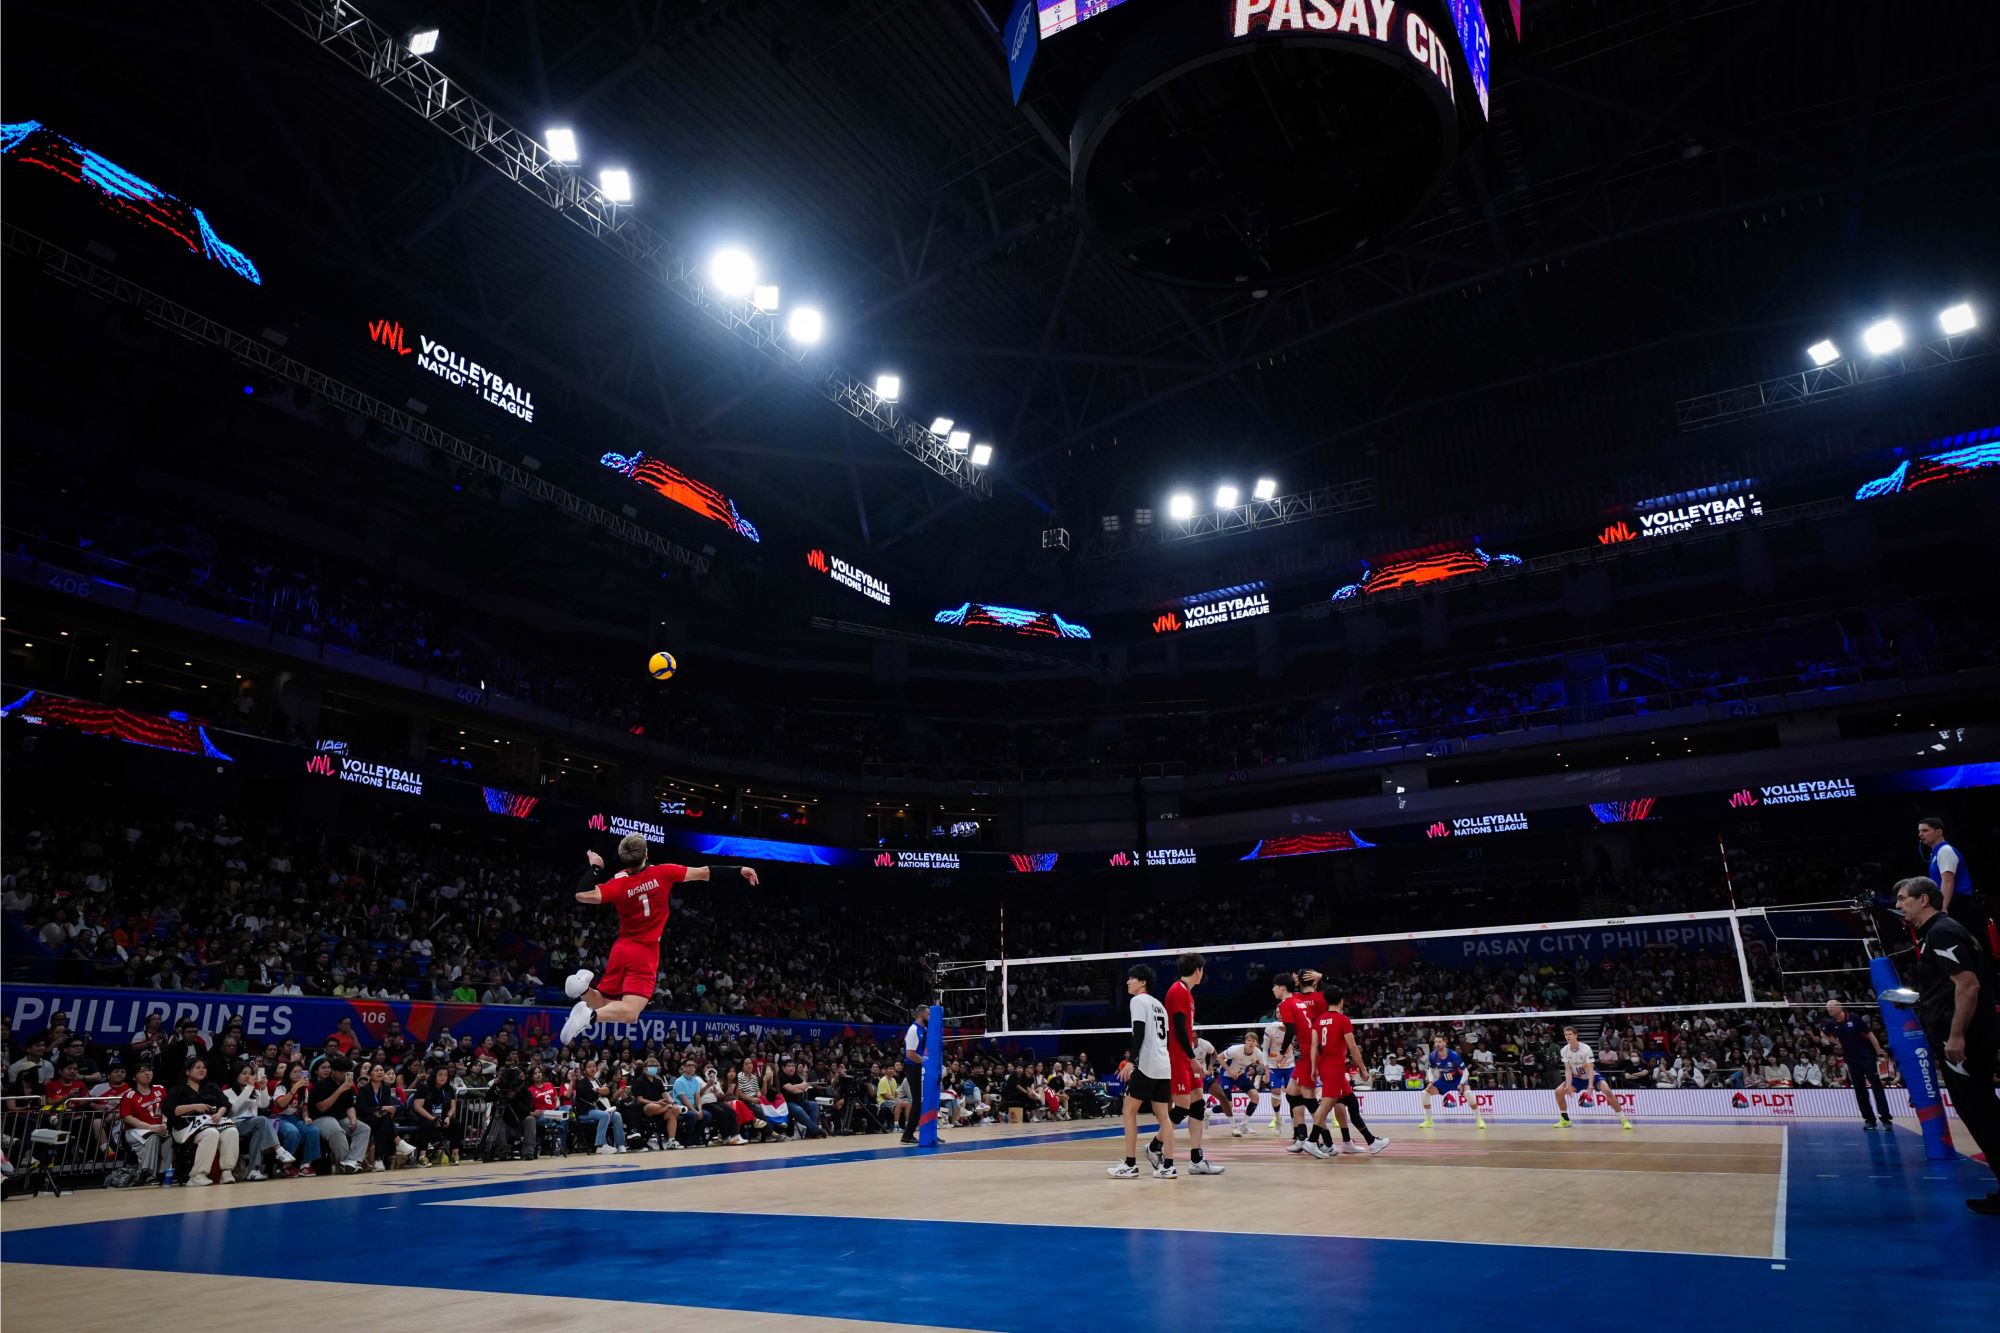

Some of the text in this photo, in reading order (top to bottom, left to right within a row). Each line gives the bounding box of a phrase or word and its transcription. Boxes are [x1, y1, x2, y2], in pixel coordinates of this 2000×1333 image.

[1233, 0, 1395, 42] PASAY
[420, 335, 534, 410] VOLLEYBALL
[483, 388, 533, 423] LEAGUE
[831, 556, 890, 596] VOLLEYBALL
[48, 575, 91, 598] 406
[831, 569, 890, 606] NATIONS LEAGUE
[1184, 594, 1269, 619] VOLLEYBALL
[1185, 605, 1270, 629] NATIONS LEAGUE
[342, 758, 423, 785] VOLLEYBALL
[340, 770, 421, 795] NATIONS LEAGUE
[1760, 778, 1855, 796] VOLLEYBALL
[1763, 788, 1856, 806] NATIONS LEAGUE
[611, 815, 665, 836] VOLLEYBALL
[1453, 812, 1527, 829] VOLLEYBALL
[1454, 822, 1528, 836] NATIONS LEAGUE
[641, 832, 665, 844] EAGUE
[898, 852, 960, 862] VOLLEYBALL
[1133, 848, 1197, 859] VLLEYBALL
[1168, 857, 1197, 865] LEAGUE
[932, 861, 960, 869] LEAGUE
[627, 879, 659, 898] NISHIDA
[639, 894, 650, 917] 1
[1463, 937, 1531, 957] PASAY
[1540, 933, 1592, 953] CITY
[361, 1011, 386, 1024] 106
[705, 1021, 740, 1032] NATIONS
[810, 1028, 821, 1037] 107
[1918, 1059, 1937, 1098] Senoh
[1459, 1095, 1494, 1106] PDT
[1751, 1094, 1794, 1107] PLDT
